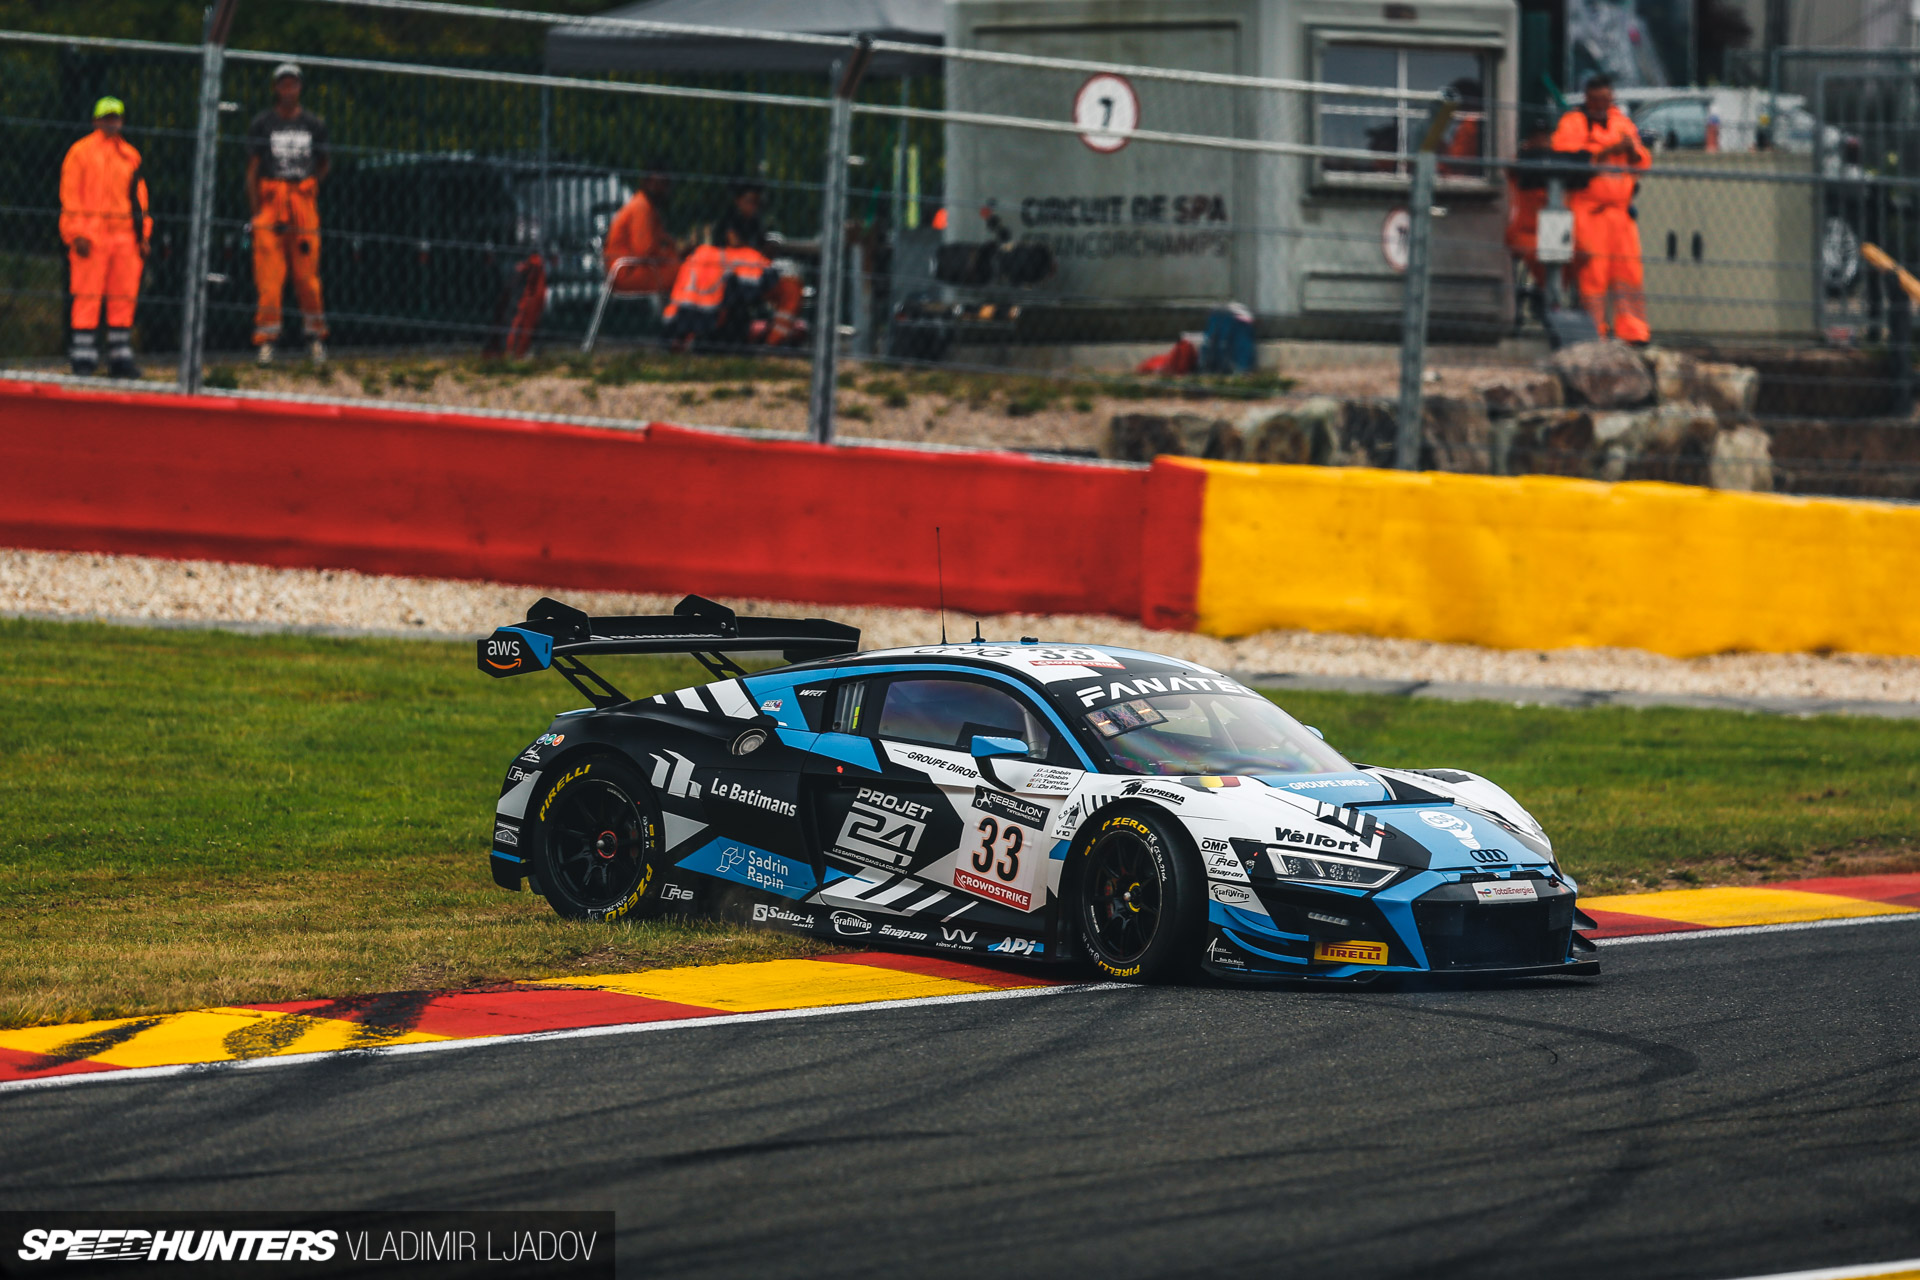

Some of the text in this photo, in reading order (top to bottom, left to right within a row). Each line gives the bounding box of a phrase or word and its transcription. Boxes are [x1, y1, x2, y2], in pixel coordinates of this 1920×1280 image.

[1021, 194, 1228, 227] CIRCUIT DE SPA
[487, 640, 520, 656] aws
[1029, 649, 1096, 661] 33
[799, 689, 827, 697] WRT
[907, 751, 979, 779] GROUPE DIROB
[539, 764, 591, 822] PIRELLI
[1288, 779, 1370, 790] GROUPE DIROB
[710, 777, 798, 818] Le Batimans
[856, 787, 934, 820] PROJET
[1140, 787, 1186, 803] SOPREMA
[989, 792, 1044, 819] REBELLION
[1111, 816, 1148, 835] ZERO
[841, 808, 920, 866] 24
[1201, 840, 1228, 852] OMP
[971, 816, 1024, 884] 33
[748, 850, 789, 876] Sadrin
[1212, 856, 1239, 868] R8
[746, 865, 784, 889] Rapin
[1208, 867, 1244, 878] Snap-on
[664, 886, 694, 900] R8
[959, 874, 1029, 906] CROWDSTRIKE
[1213, 888, 1250, 900] GrafiWrap
[1492, 887, 1535, 897] TotalEnergies
[767, 906, 815, 925] Saito-k
[833, 915, 873, 931] GrafiWrap
[878, 923, 928, 942] Snap-on
[1321, 942, 1382, 961] PIRELLI
[1097, 960, 1140, 976] PIRELLI
